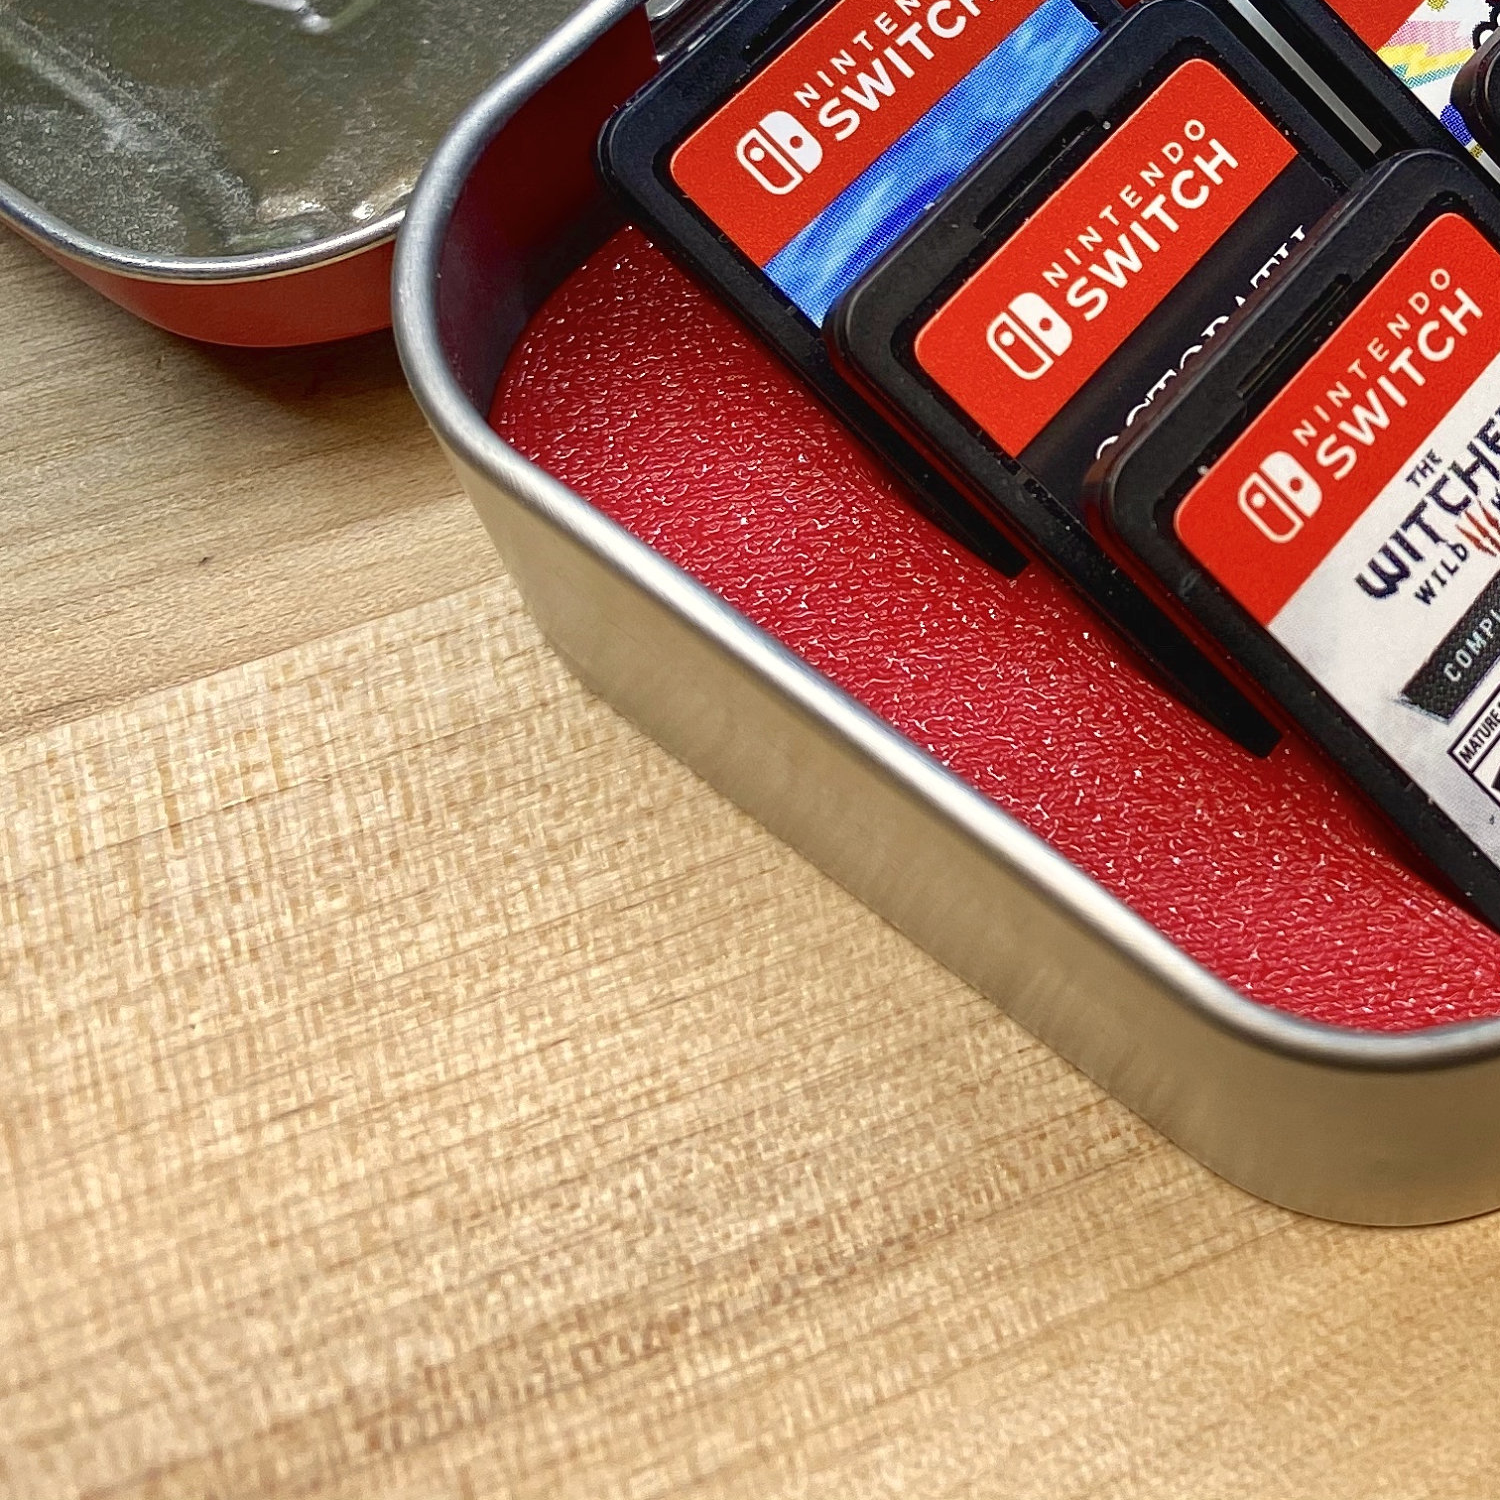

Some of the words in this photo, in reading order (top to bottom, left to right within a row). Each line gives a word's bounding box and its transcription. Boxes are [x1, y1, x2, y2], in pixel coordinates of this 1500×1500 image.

[1041, 119, 1206, 288] NINTENDO
[1066, 138, 1239, 322] SWITCH
[1292, 268, 1450, 447] NINTENDO
[1316, 288, 1483, 481] SWITCH
[1405, 449, 1443, 489] THE
[1413, 541, 1470, 606] WILD
